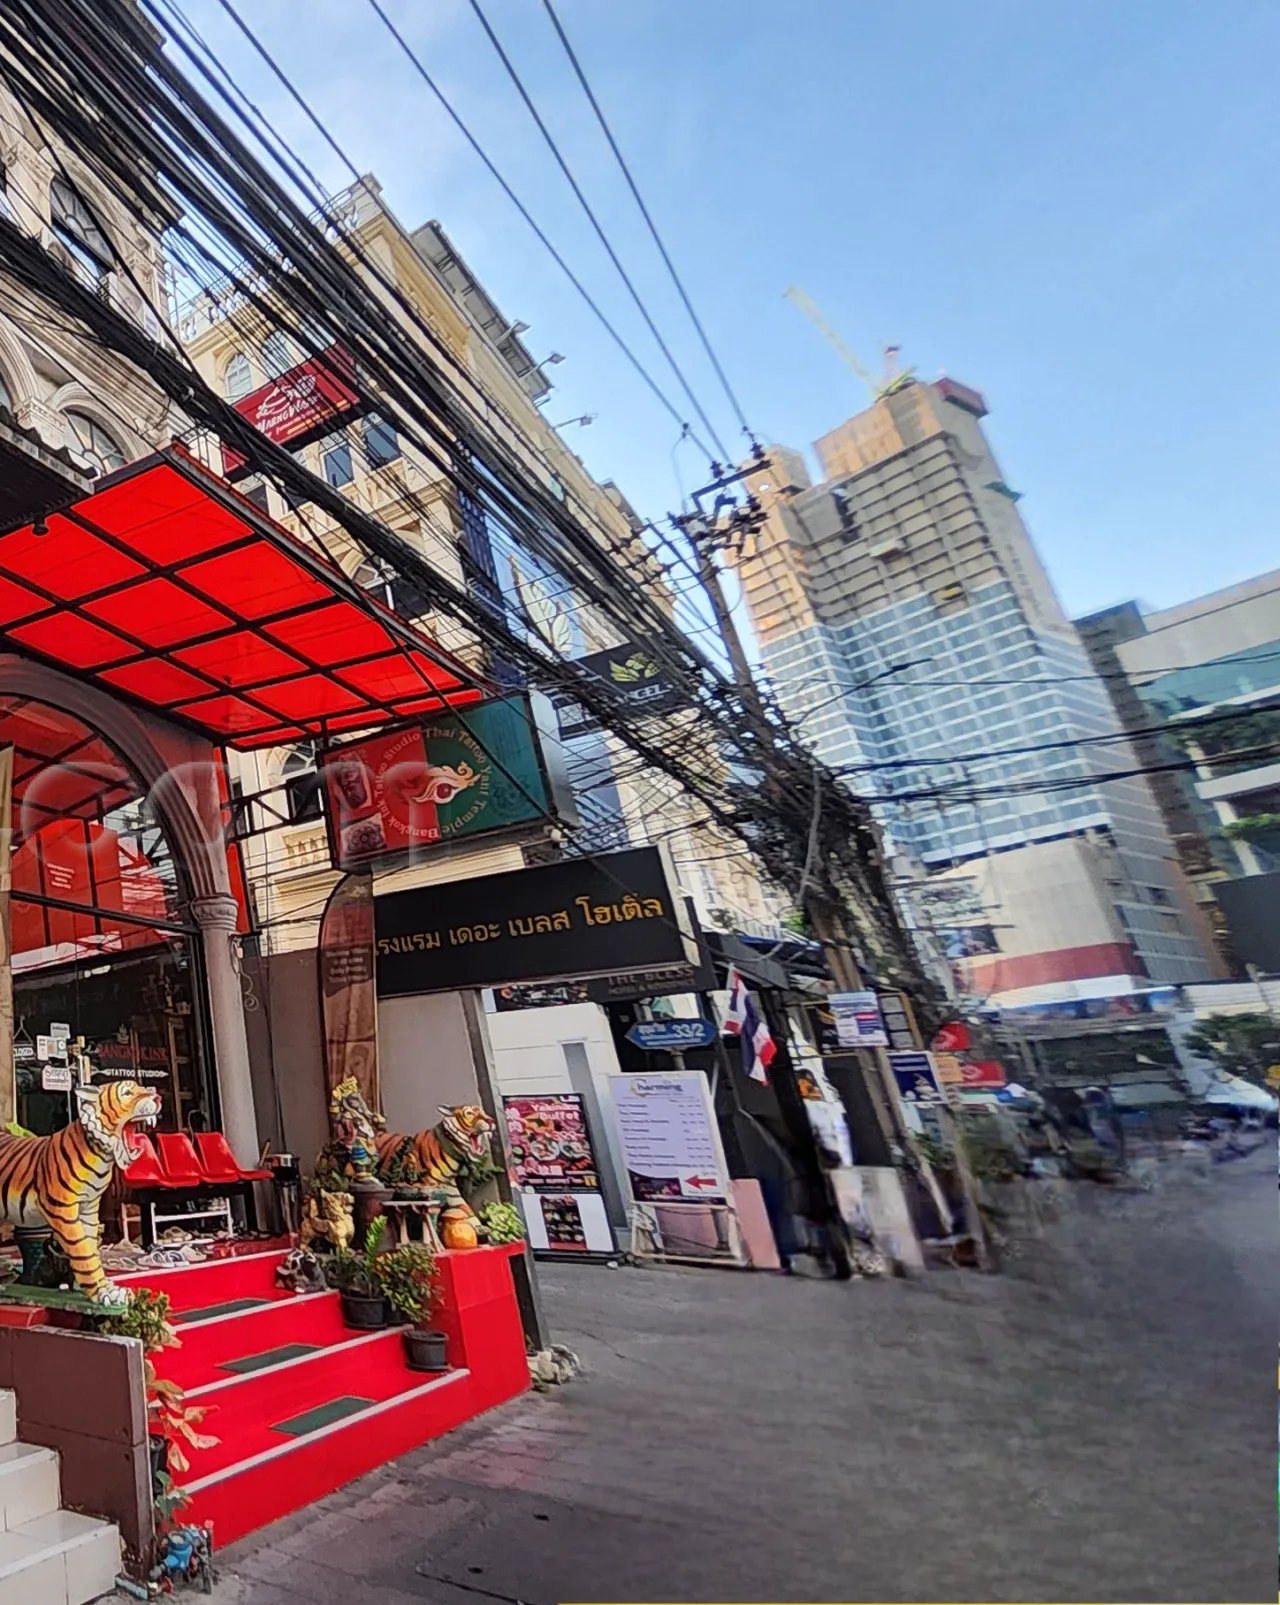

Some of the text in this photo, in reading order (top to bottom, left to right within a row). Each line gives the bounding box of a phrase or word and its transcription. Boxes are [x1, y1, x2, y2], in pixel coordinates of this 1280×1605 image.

[383, 733, 421, 761] Studio
[422, 725, 457, 740] Thai
[374, 930, 442, 955] รงแรม
[449, 923, 501, 945] เดอะ
[508, 910, 571, 937] เบลส
